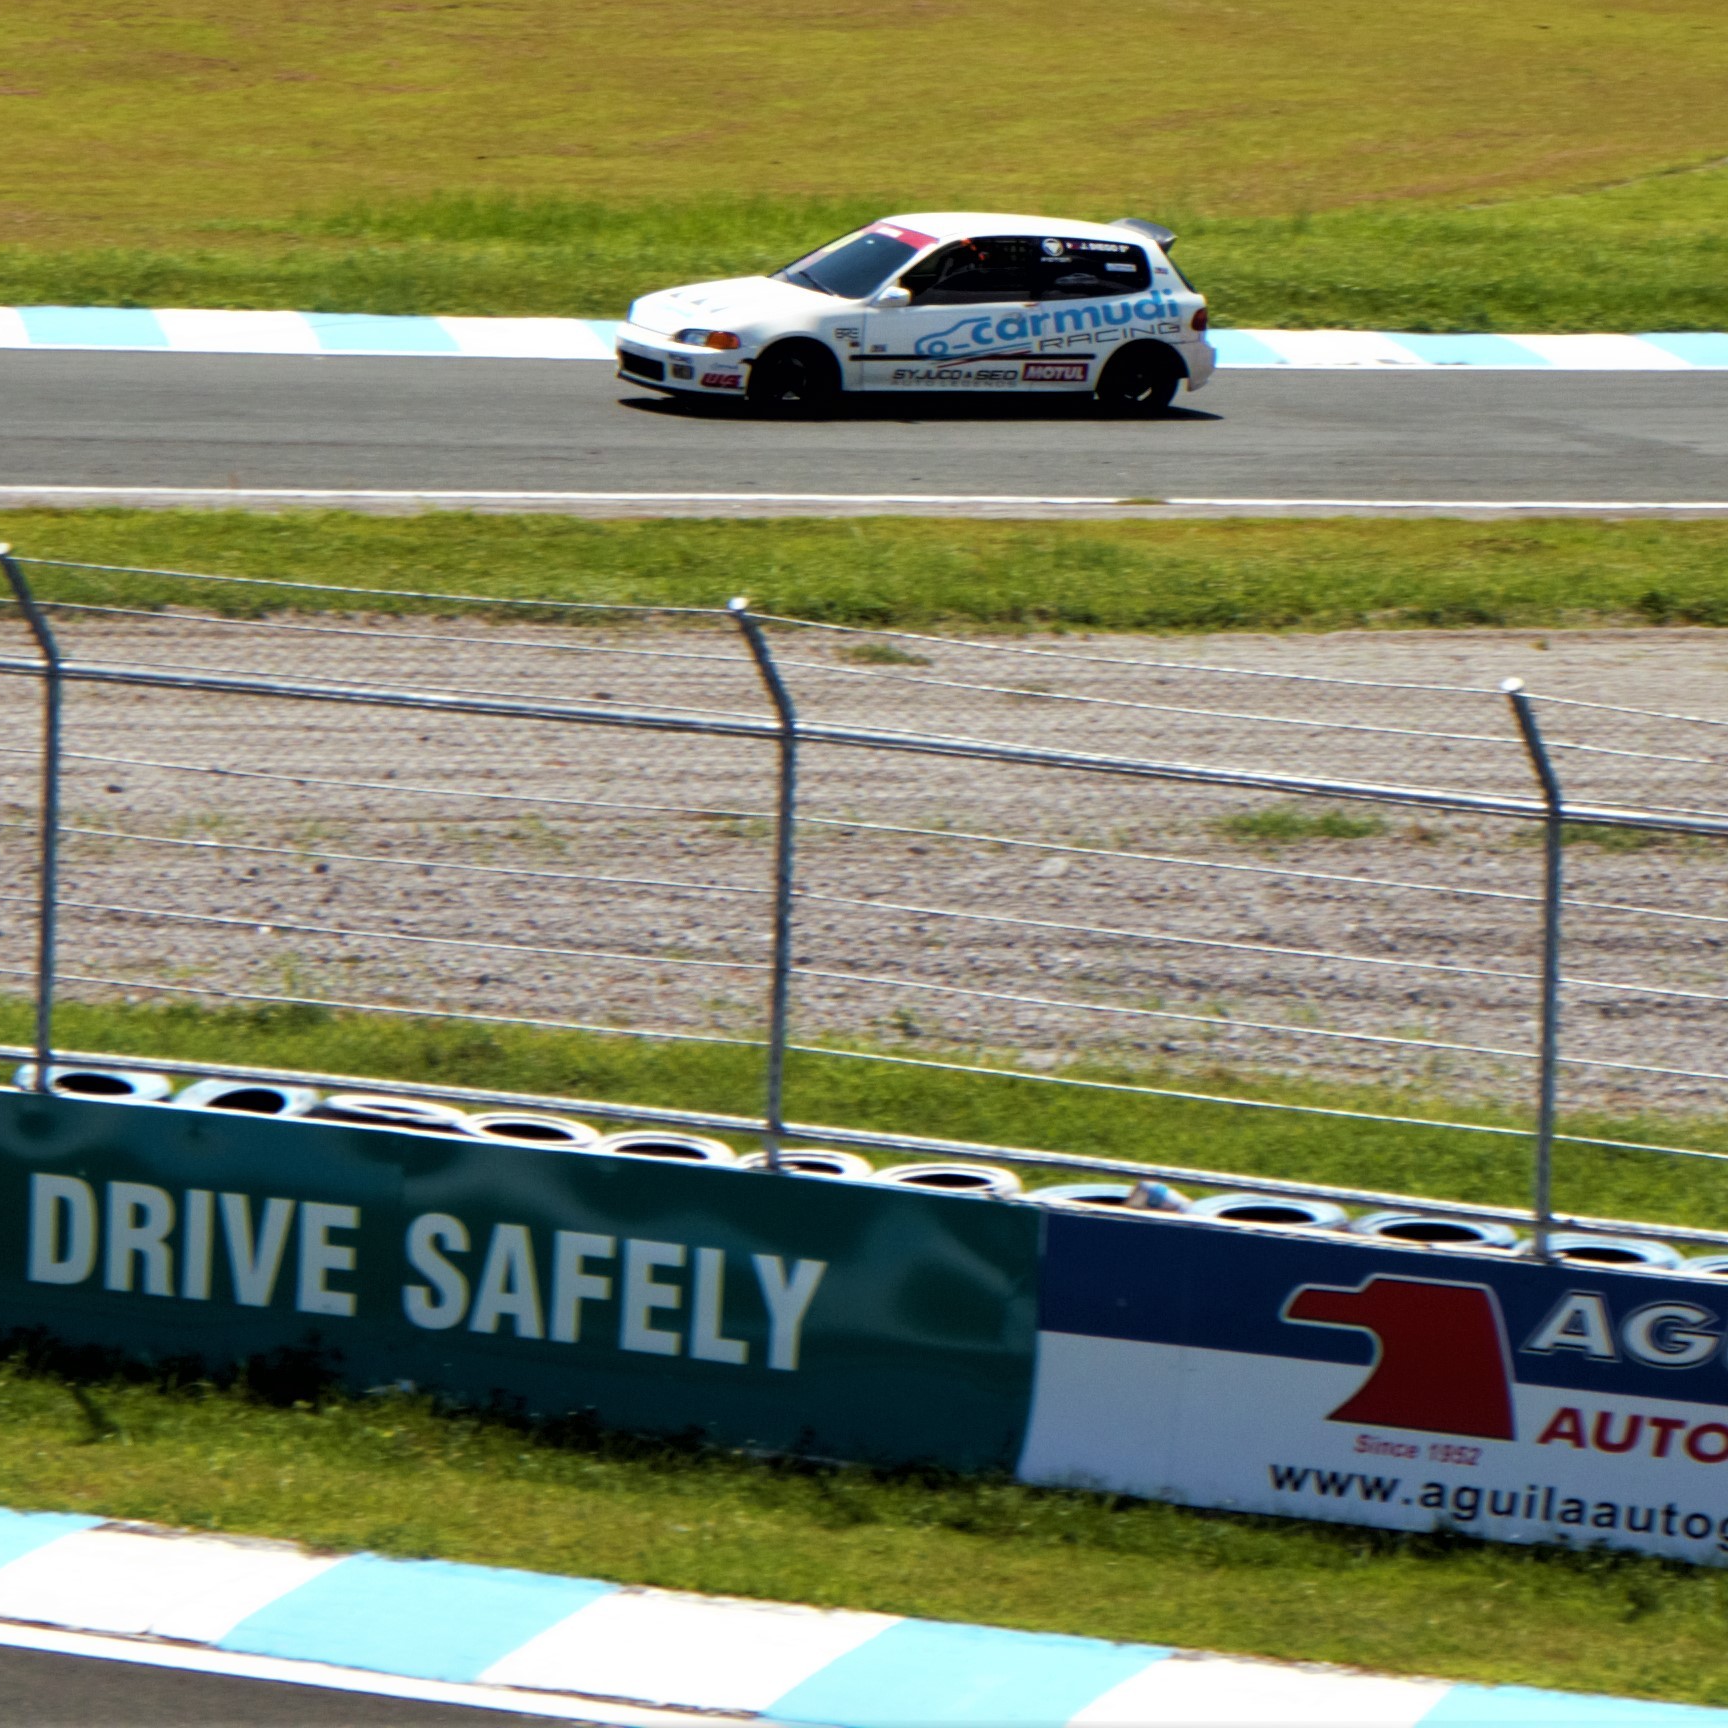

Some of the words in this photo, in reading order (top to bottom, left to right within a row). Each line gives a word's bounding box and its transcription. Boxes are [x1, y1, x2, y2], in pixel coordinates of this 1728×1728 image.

[970, 288, 1180, 344] carmudi
[1038, 322, 1181, 352] RACING
[1027, 364, 1085, 381] MOTUL
[27, 1172, 361, 1317] DRIVE
[401, 1212, 828, 1371] SAFELY
[1354, 1433, 1419, 1459] Since
